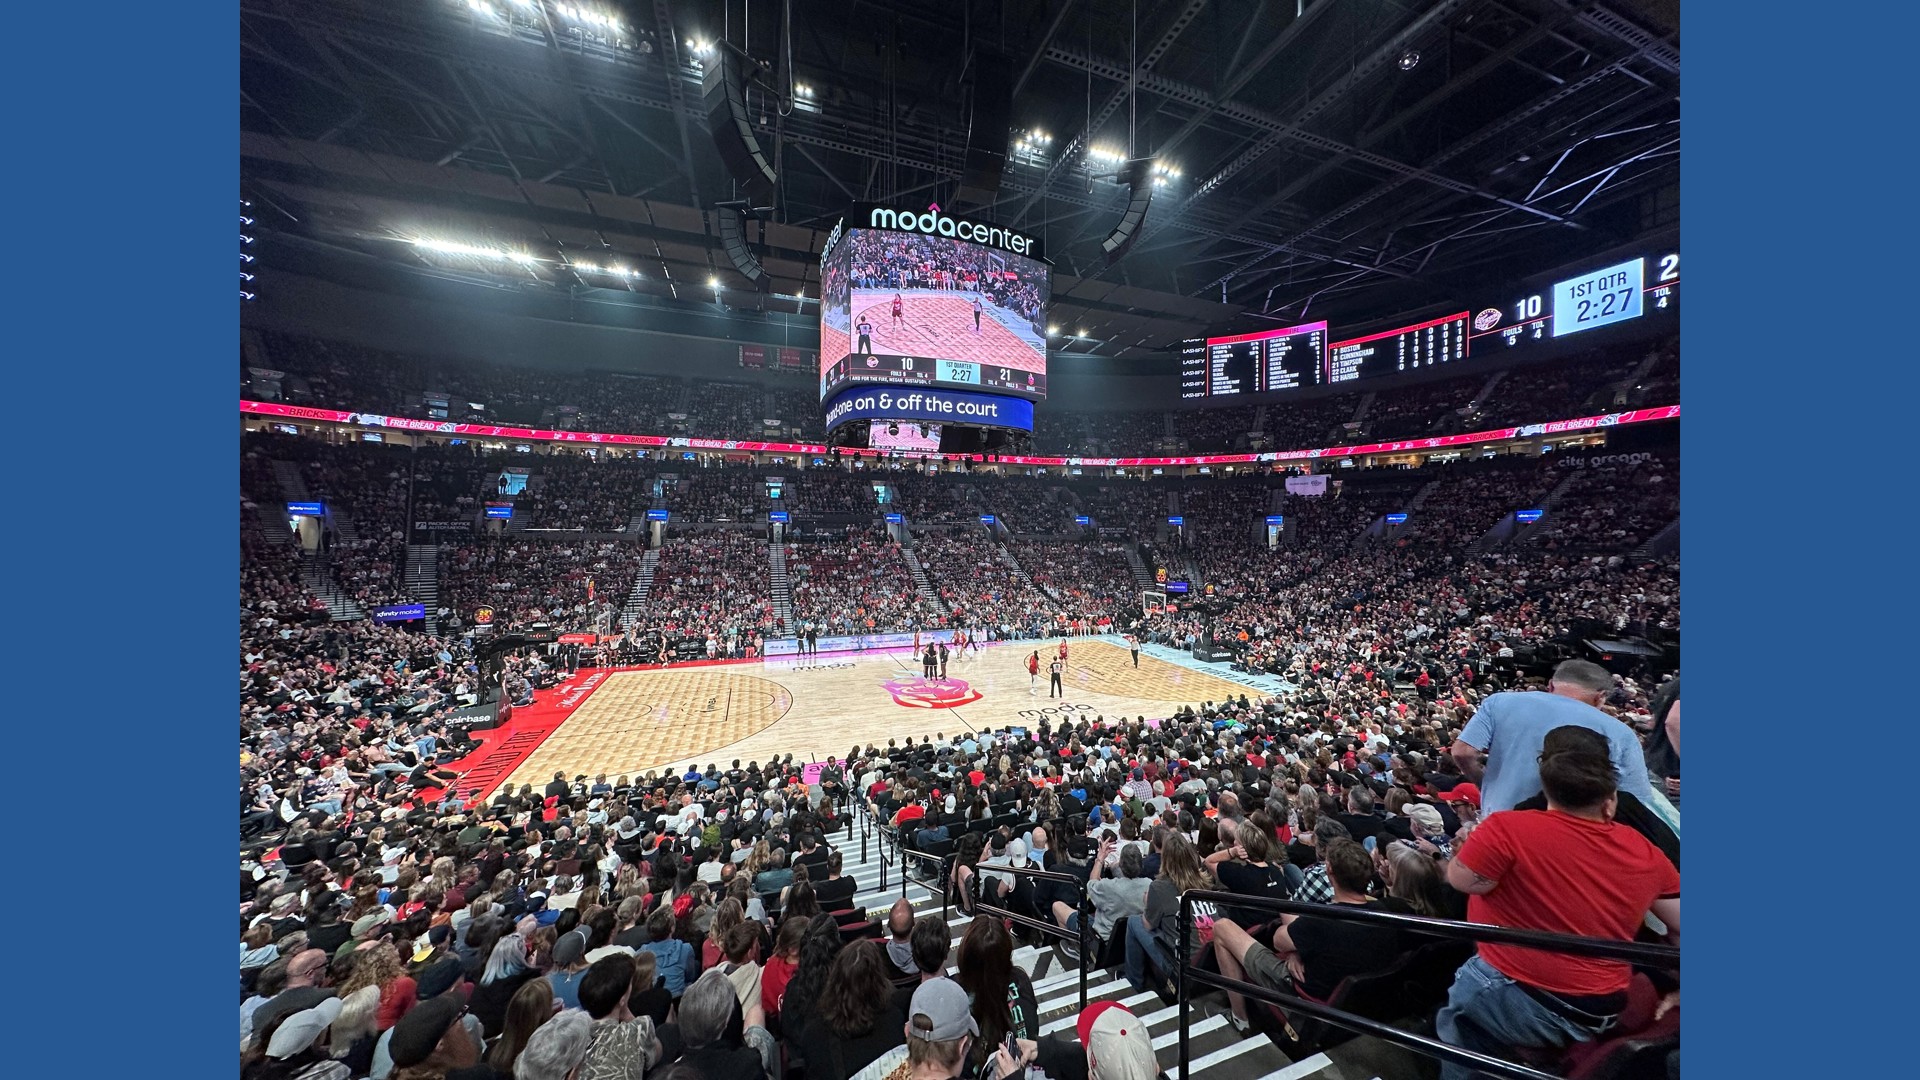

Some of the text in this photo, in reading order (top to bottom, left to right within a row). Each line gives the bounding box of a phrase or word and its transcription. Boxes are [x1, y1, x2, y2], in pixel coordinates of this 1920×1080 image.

[871, 208, 1034, 256] modacenter
[1570, 271, 1627, 299] 1ST QTR
[1654, 287, 1671, 297] TOL
[1516, 294, 1541, 320] 10
[1577, 287, 1634, 323] 2:27
[1657, 297, 1668, 308] 4
[1503, 320, 1544, 337] FOULS TOL
[1509, 328, 1542, 345] 5 4
[901, 357, 913, 370] 10
[952, 369, 971, 382] 2:27
[1000, 369, 1010, 381] 21
[855, 397, 874, 410] on
[879, 394, 893, 409] &
[897, 394, 923, 410] off
[925, 396, 952, 413] the
[956, 402, 998, 418] court
[289, 408, 434, 430] BRICKS FREE BREAD
[1473, 419, 1594, 441] BRICKS FREE BREAD
[1558, 456, 1584, 467] city
[1018, 703, 1094, 717] moda
